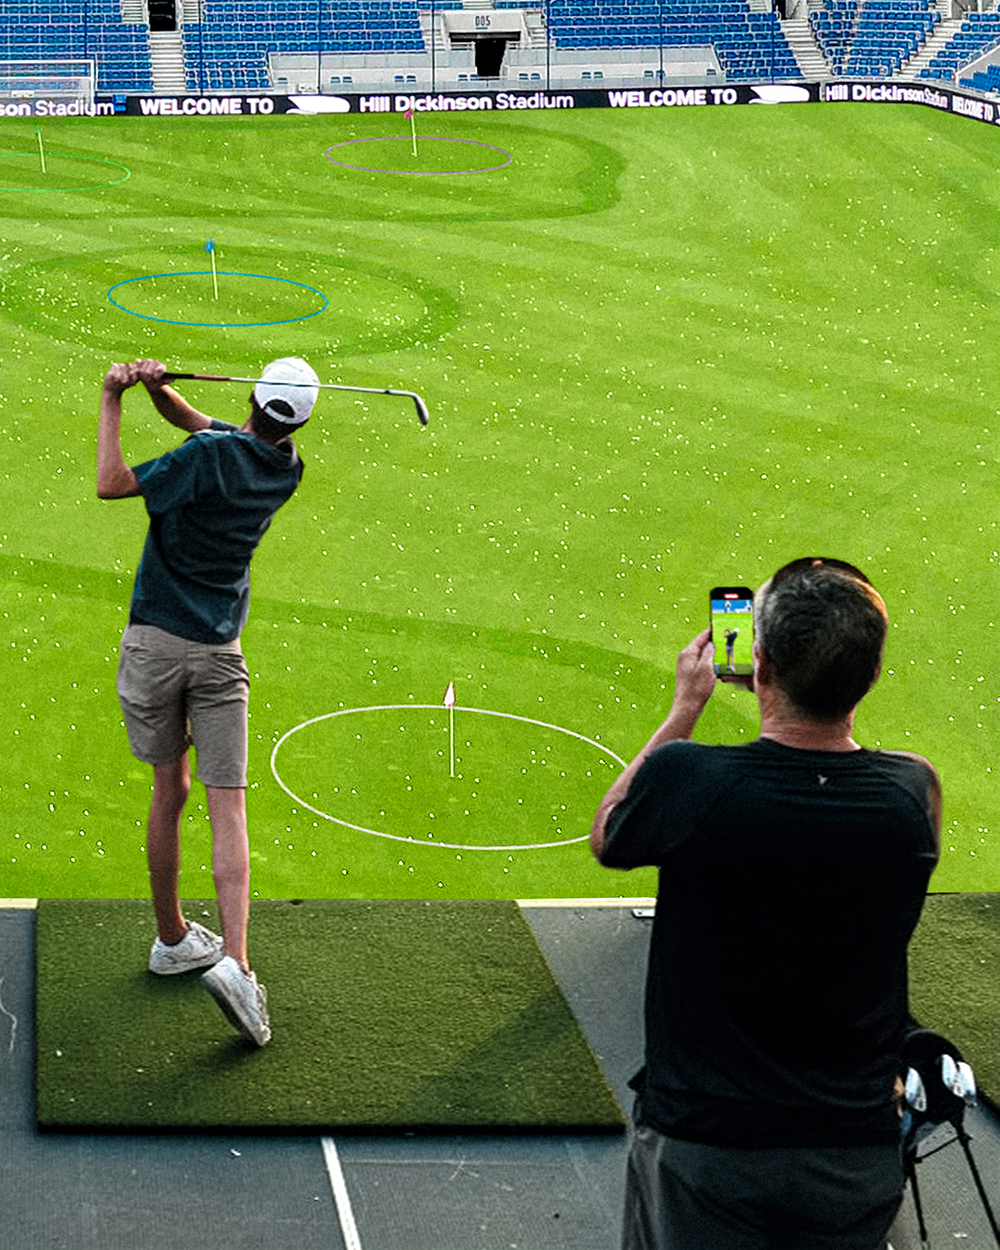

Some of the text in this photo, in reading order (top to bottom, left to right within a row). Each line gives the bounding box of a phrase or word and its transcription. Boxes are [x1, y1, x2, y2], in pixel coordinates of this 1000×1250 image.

[475, 15, 491, 26] 005
[359, 92, 575, 112] Hill Dickinson Stadium
[608, 88, 738, 107] WELCOME TO
[824, 84, 849, 101] Hill
[852, 84, 924, 103] Dickinson
[35, 99, 115, 117] Stadium
[139, 98, 274, 115] WELCOME TO
